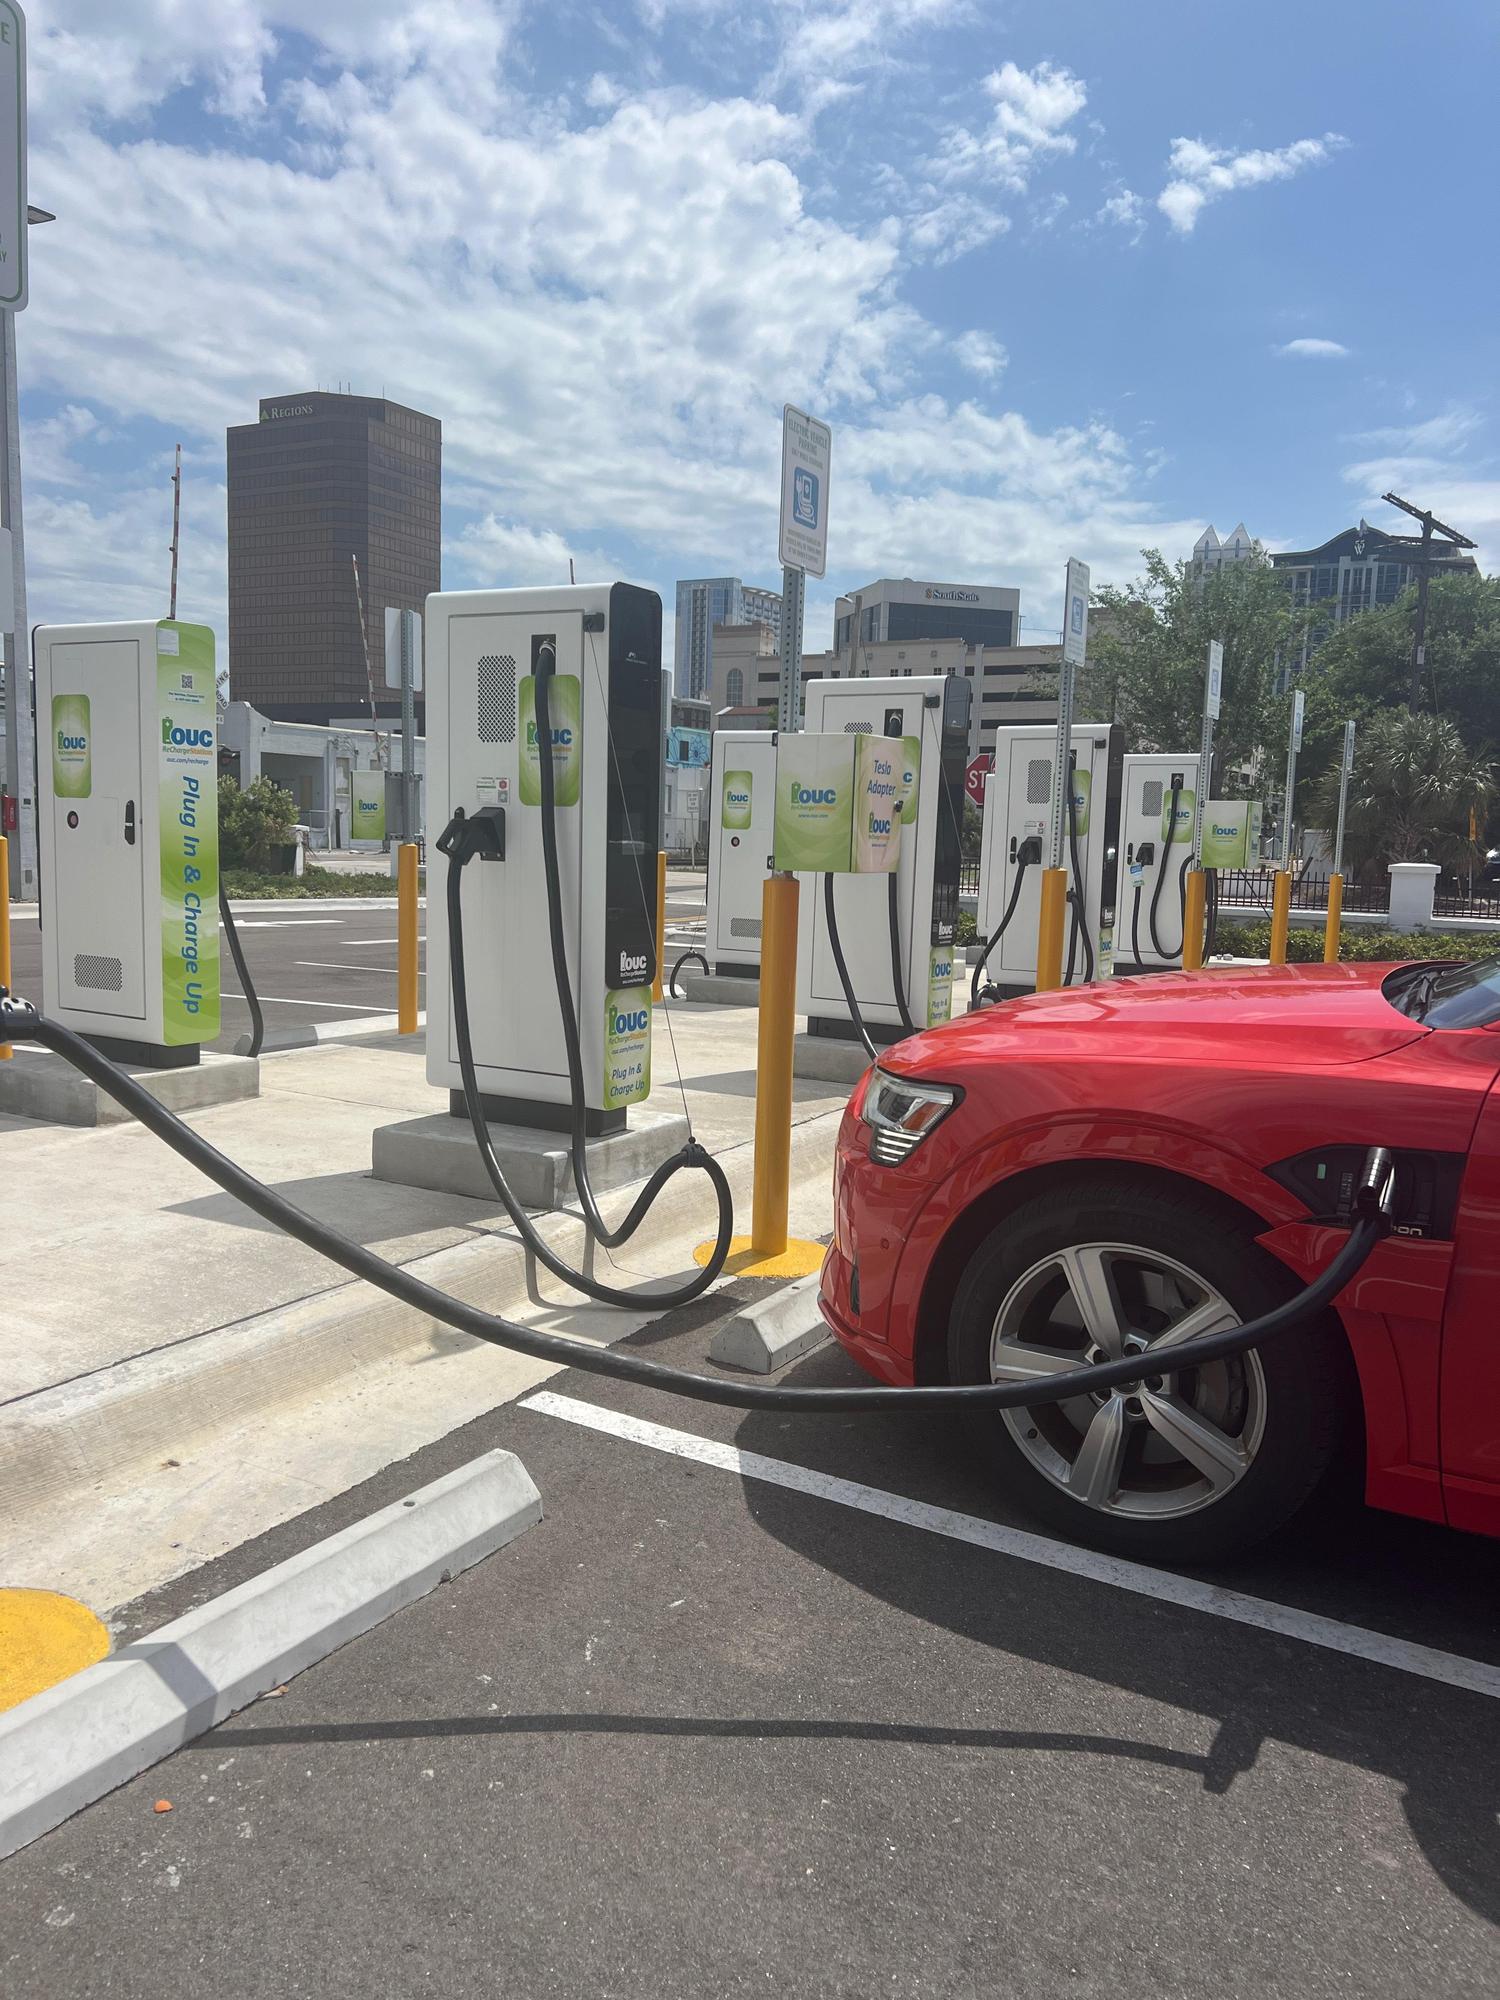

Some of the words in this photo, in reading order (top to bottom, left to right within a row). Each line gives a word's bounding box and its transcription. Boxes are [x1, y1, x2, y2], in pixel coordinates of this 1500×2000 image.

[874, 759, 892, 776] Tesla
[968, 770, 987, 789] ST
[866, 781, 896, 798] Adapter
[180, 775, 201, 828] Plug
[183, 835, 200, 857] In
[183, 864, 201, 884] &
[181, 892, 202, 974] Charge
[182, 983, 202, 1014] Up
[611, 1067, 627, 1081] Plug
[628, 1065, 635, 1076] In
[635, 1063, 642, 1074] &
[610, 1083, 634, 1097] Charge
[635, 1079, 645, 1092] Up
